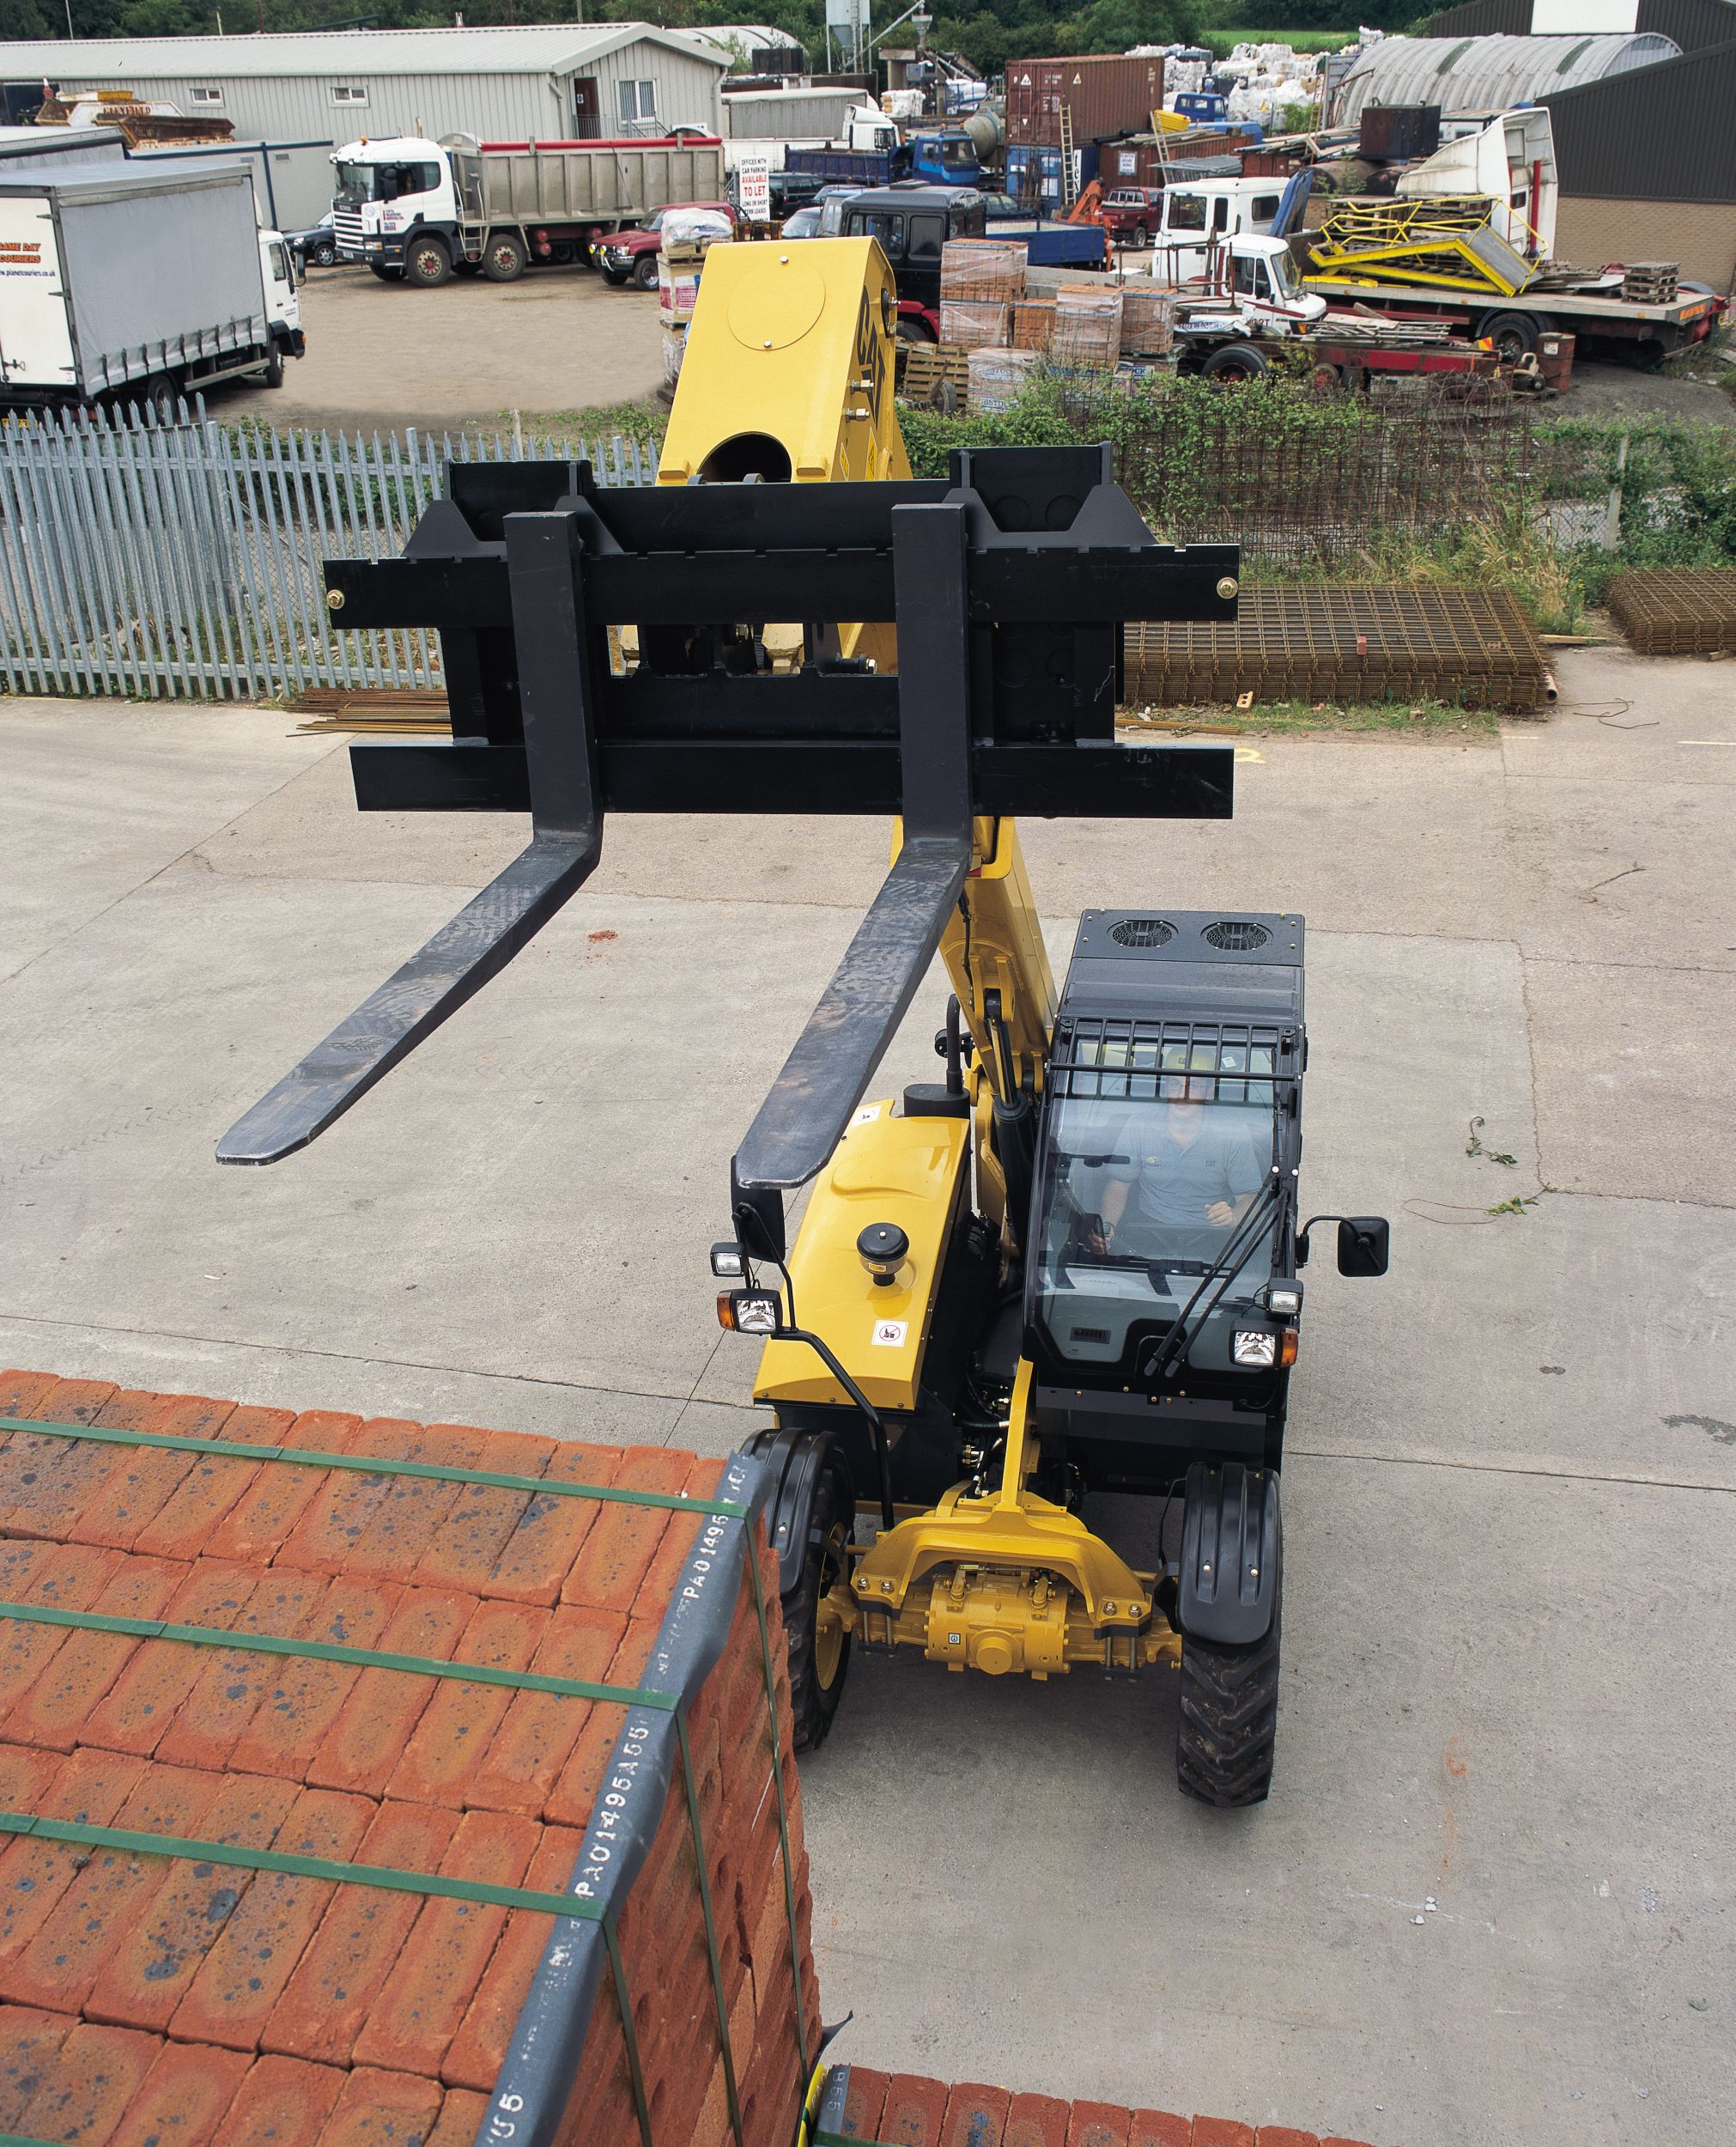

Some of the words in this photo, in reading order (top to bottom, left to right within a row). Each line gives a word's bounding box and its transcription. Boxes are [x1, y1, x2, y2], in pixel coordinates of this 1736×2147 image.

[744, 186, 752, 197] TO
[754, 186, 766, 196] LET
[22, 243, 41, 252] DAY
[0, 254, 40, 263] COURIERS
[857, 284, 886, 430] CAT
[574, 1726, 649, 1897] PA01495A55
